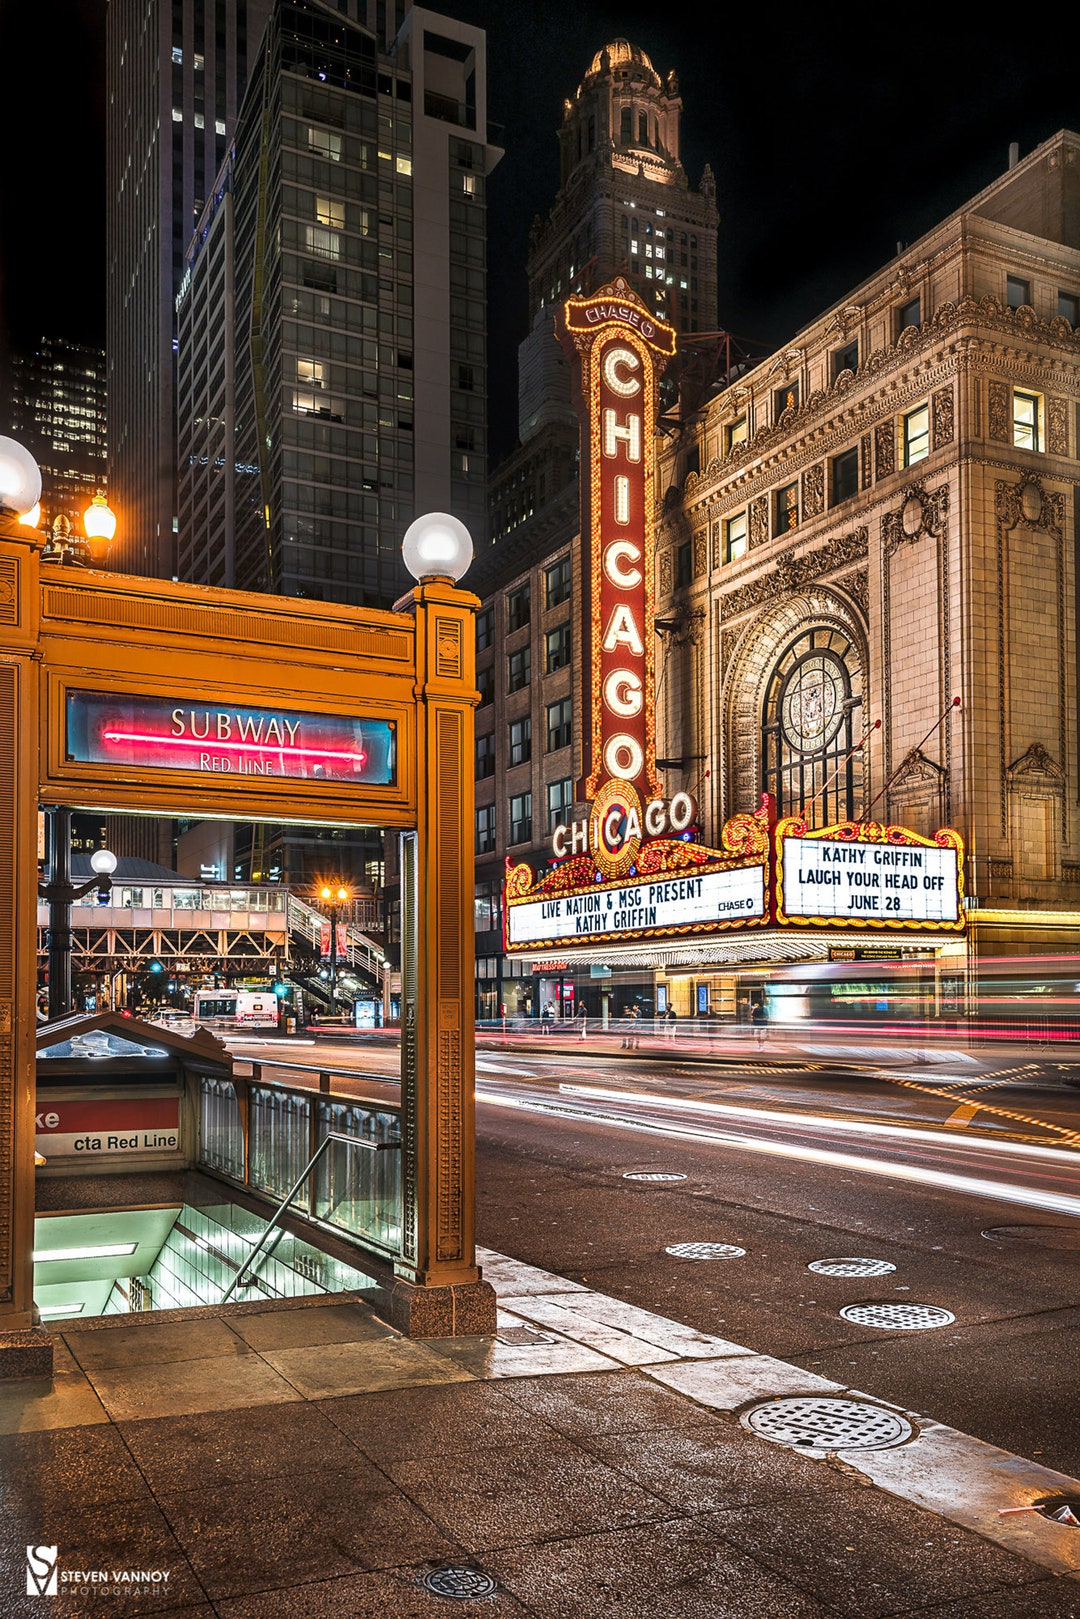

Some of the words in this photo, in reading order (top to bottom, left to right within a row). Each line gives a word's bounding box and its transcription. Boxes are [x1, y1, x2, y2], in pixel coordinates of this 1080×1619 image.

[585, 304, 640, 327] CHASE
[601, 347, 645, 782] CHICAGO
[171, 708, 301, 746] SUBWAY
[552, 791, 693, 858] CHICAGO
[822, 846, 866, 864] KATHY
[873, 850, 922, 867] GRIFFIN
[798, 868, 841, 885] LAUGH
[846, 871, 880, 888] YOUR
[885, 874, 918, 890] HEAD
[923, 876, 945, 890] OFF
[541, 901, 561, 919] LIVE
[566, 895, 600, 915] NATION
[606, 893, 613, 909] &
[619, 888, 642, 907] MSG
[649, 878, 703, 904] PRESENT
[718, 900, 745, 912] CHASE
[847, 895, 879, 910] JUNE
[885, 896, 901, 911] 28
[575, 914, 607, 933] KATHY
[613, 907, 657, 928] GRIFFIN
[74, 1137, 101, 1150] cta
[107, 1136, 139, 1149] Red
[144, 1134, 176, 1147] Line
